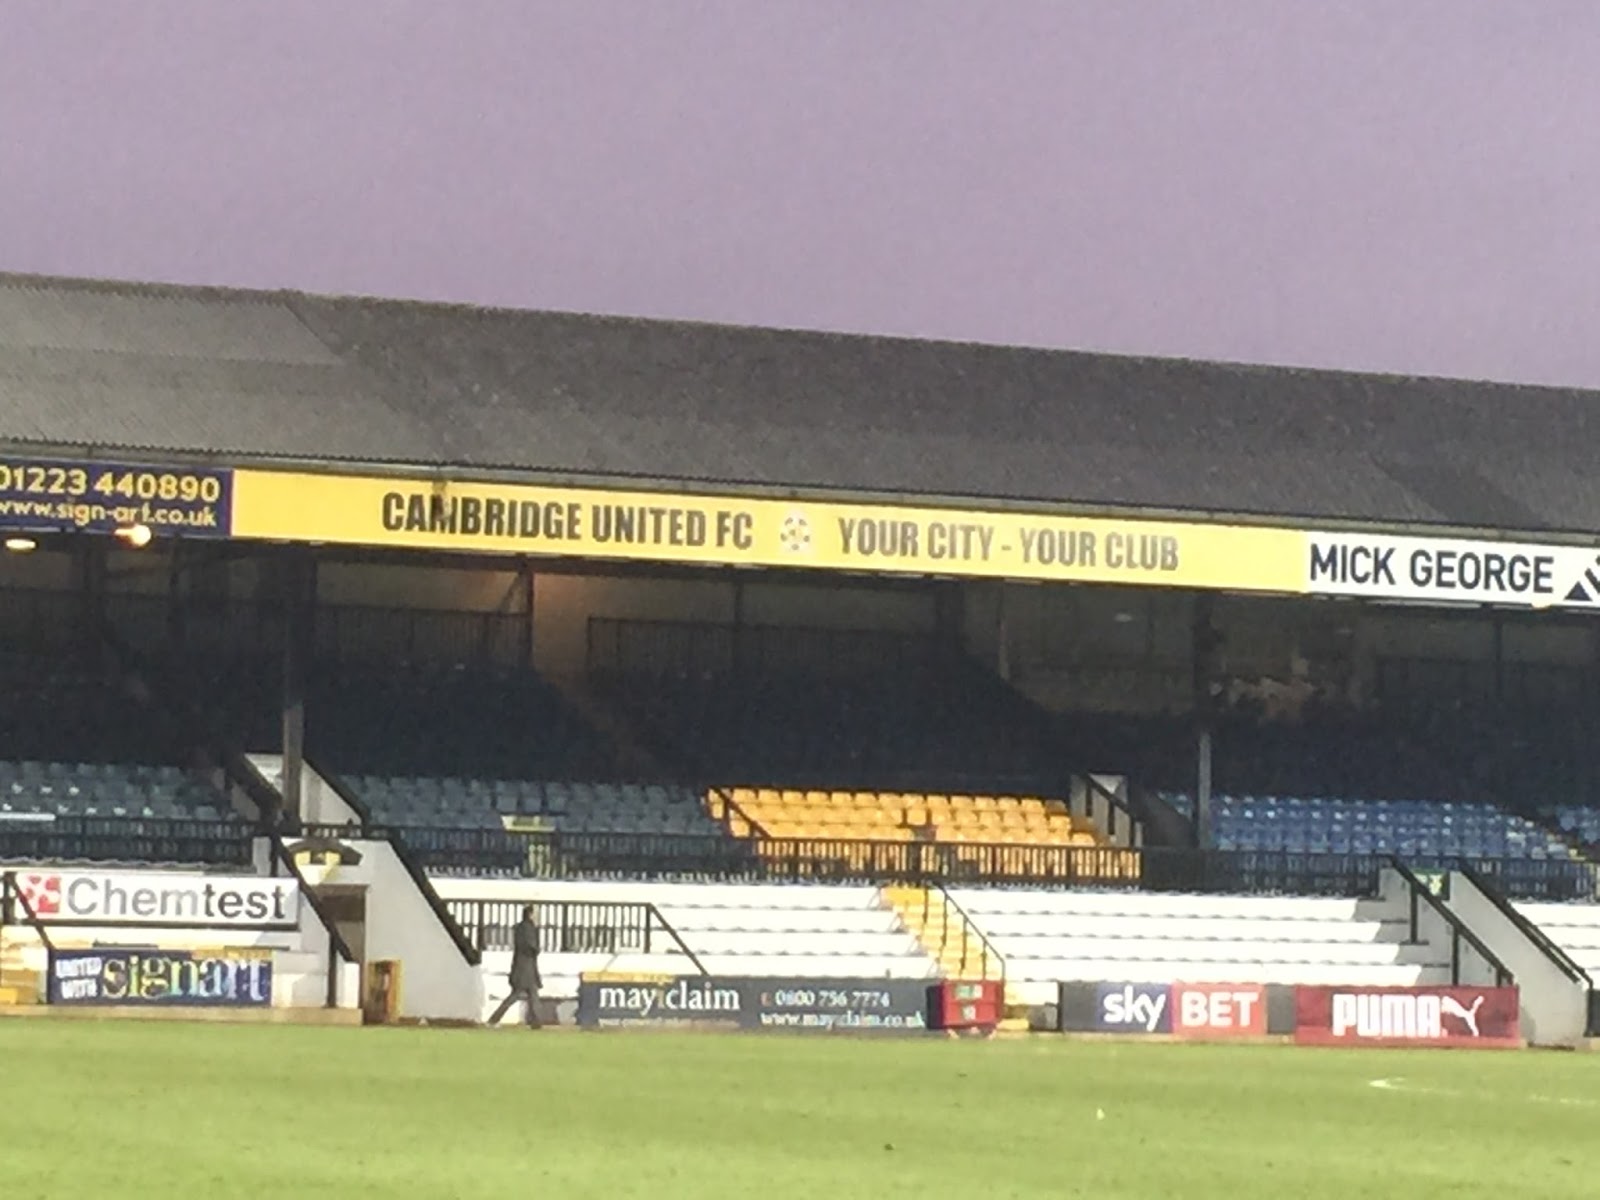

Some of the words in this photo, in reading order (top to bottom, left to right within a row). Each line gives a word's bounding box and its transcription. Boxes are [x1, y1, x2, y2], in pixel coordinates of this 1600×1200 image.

[0, 465, 87, 496] 01223
[94, 471, 220, 502] 440890
[382, 492, 581, 540] CAMBRIDGE
[592, 504, 706, 547] UNITED
[715, 511, 753, 550] FC
[838, 517, 919, 557] YOUR
[927, 522, 994, 561] CITY
[1020, 527, 1097, 567] YOUR
[1105, 532, 1179, 572] CLUB
[1310, 543, 1396, 586] MICK
[1410, 549, 1554, 594] GEORGE
[67, 877, 286, 919] Chemtest
[102, 955, 268, 1001] signart
[1103, 985, 1166, 1032] sky
[1180, 991, 1258, 1028] BET
[1332, 993, 1443, 1037] PUMA
